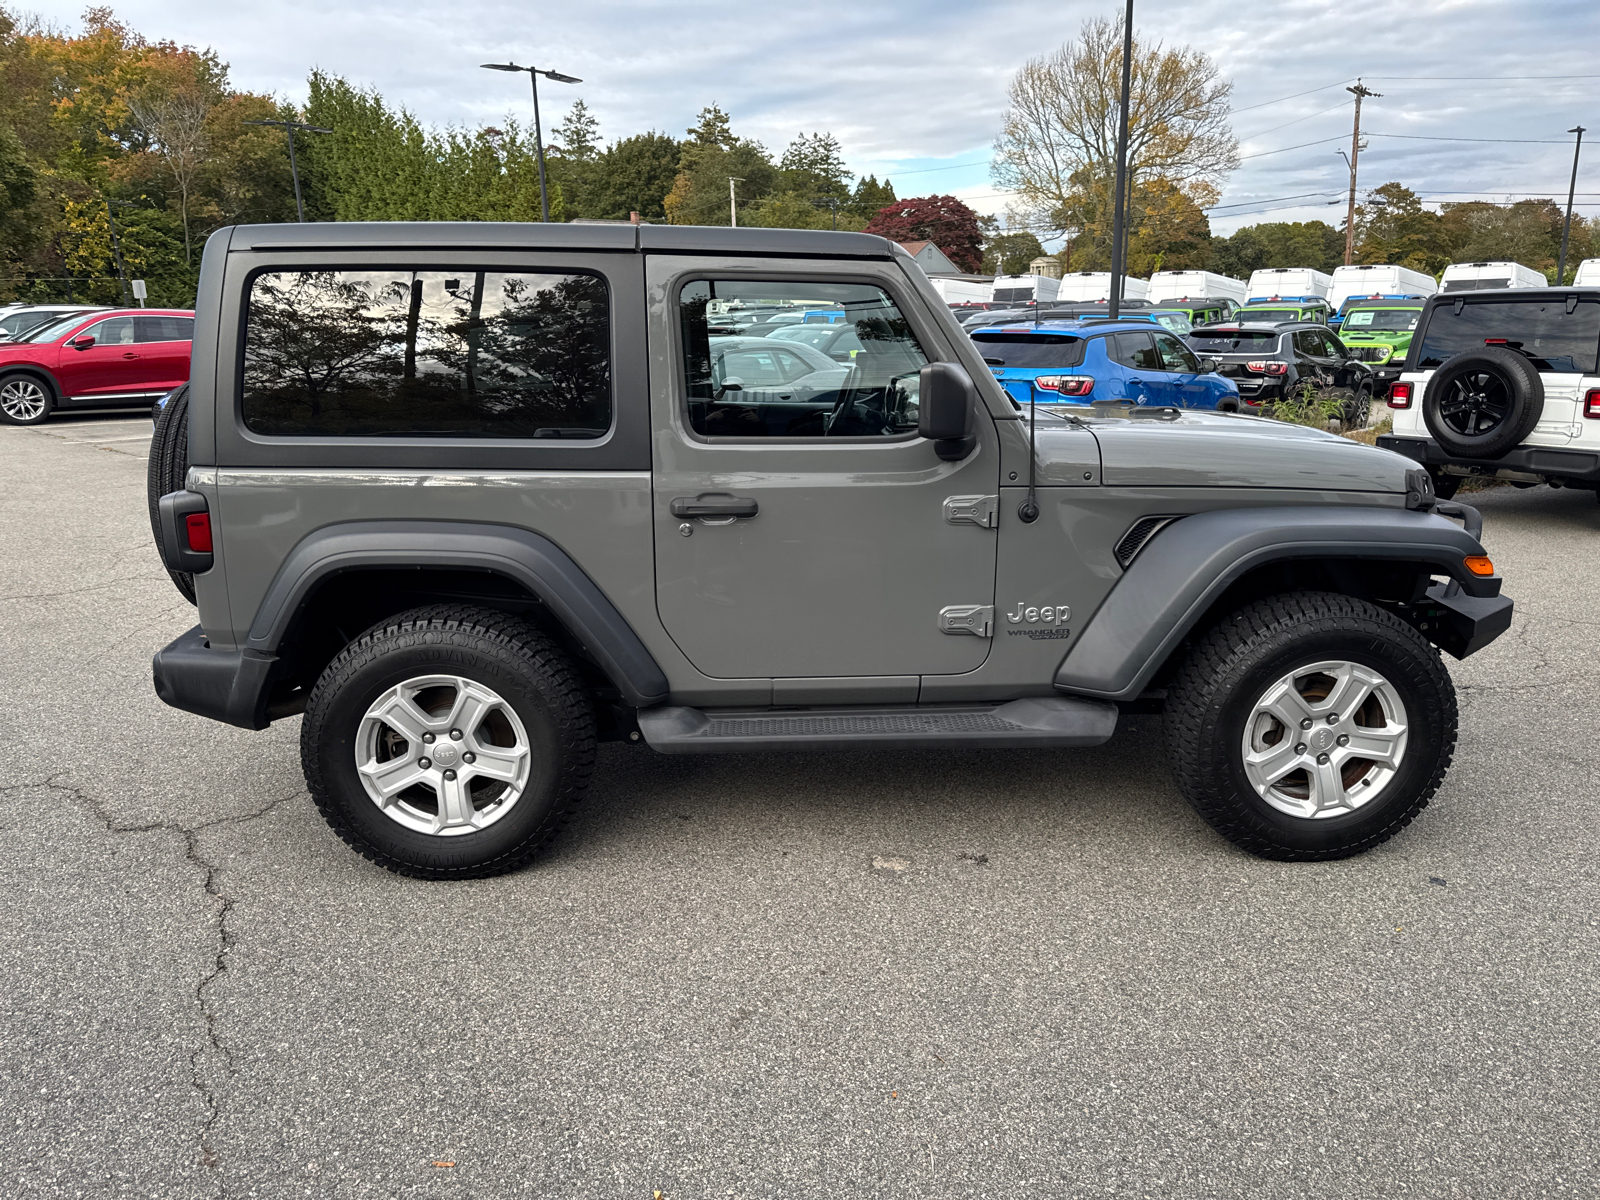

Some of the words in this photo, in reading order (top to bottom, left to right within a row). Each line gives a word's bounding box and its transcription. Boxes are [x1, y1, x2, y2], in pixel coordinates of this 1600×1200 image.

[1007, 602, 1072, 626] Jeep
[1007, 628, 1070, 636] WRANGLER
[416, 648, 501, 677] ADVANTA
